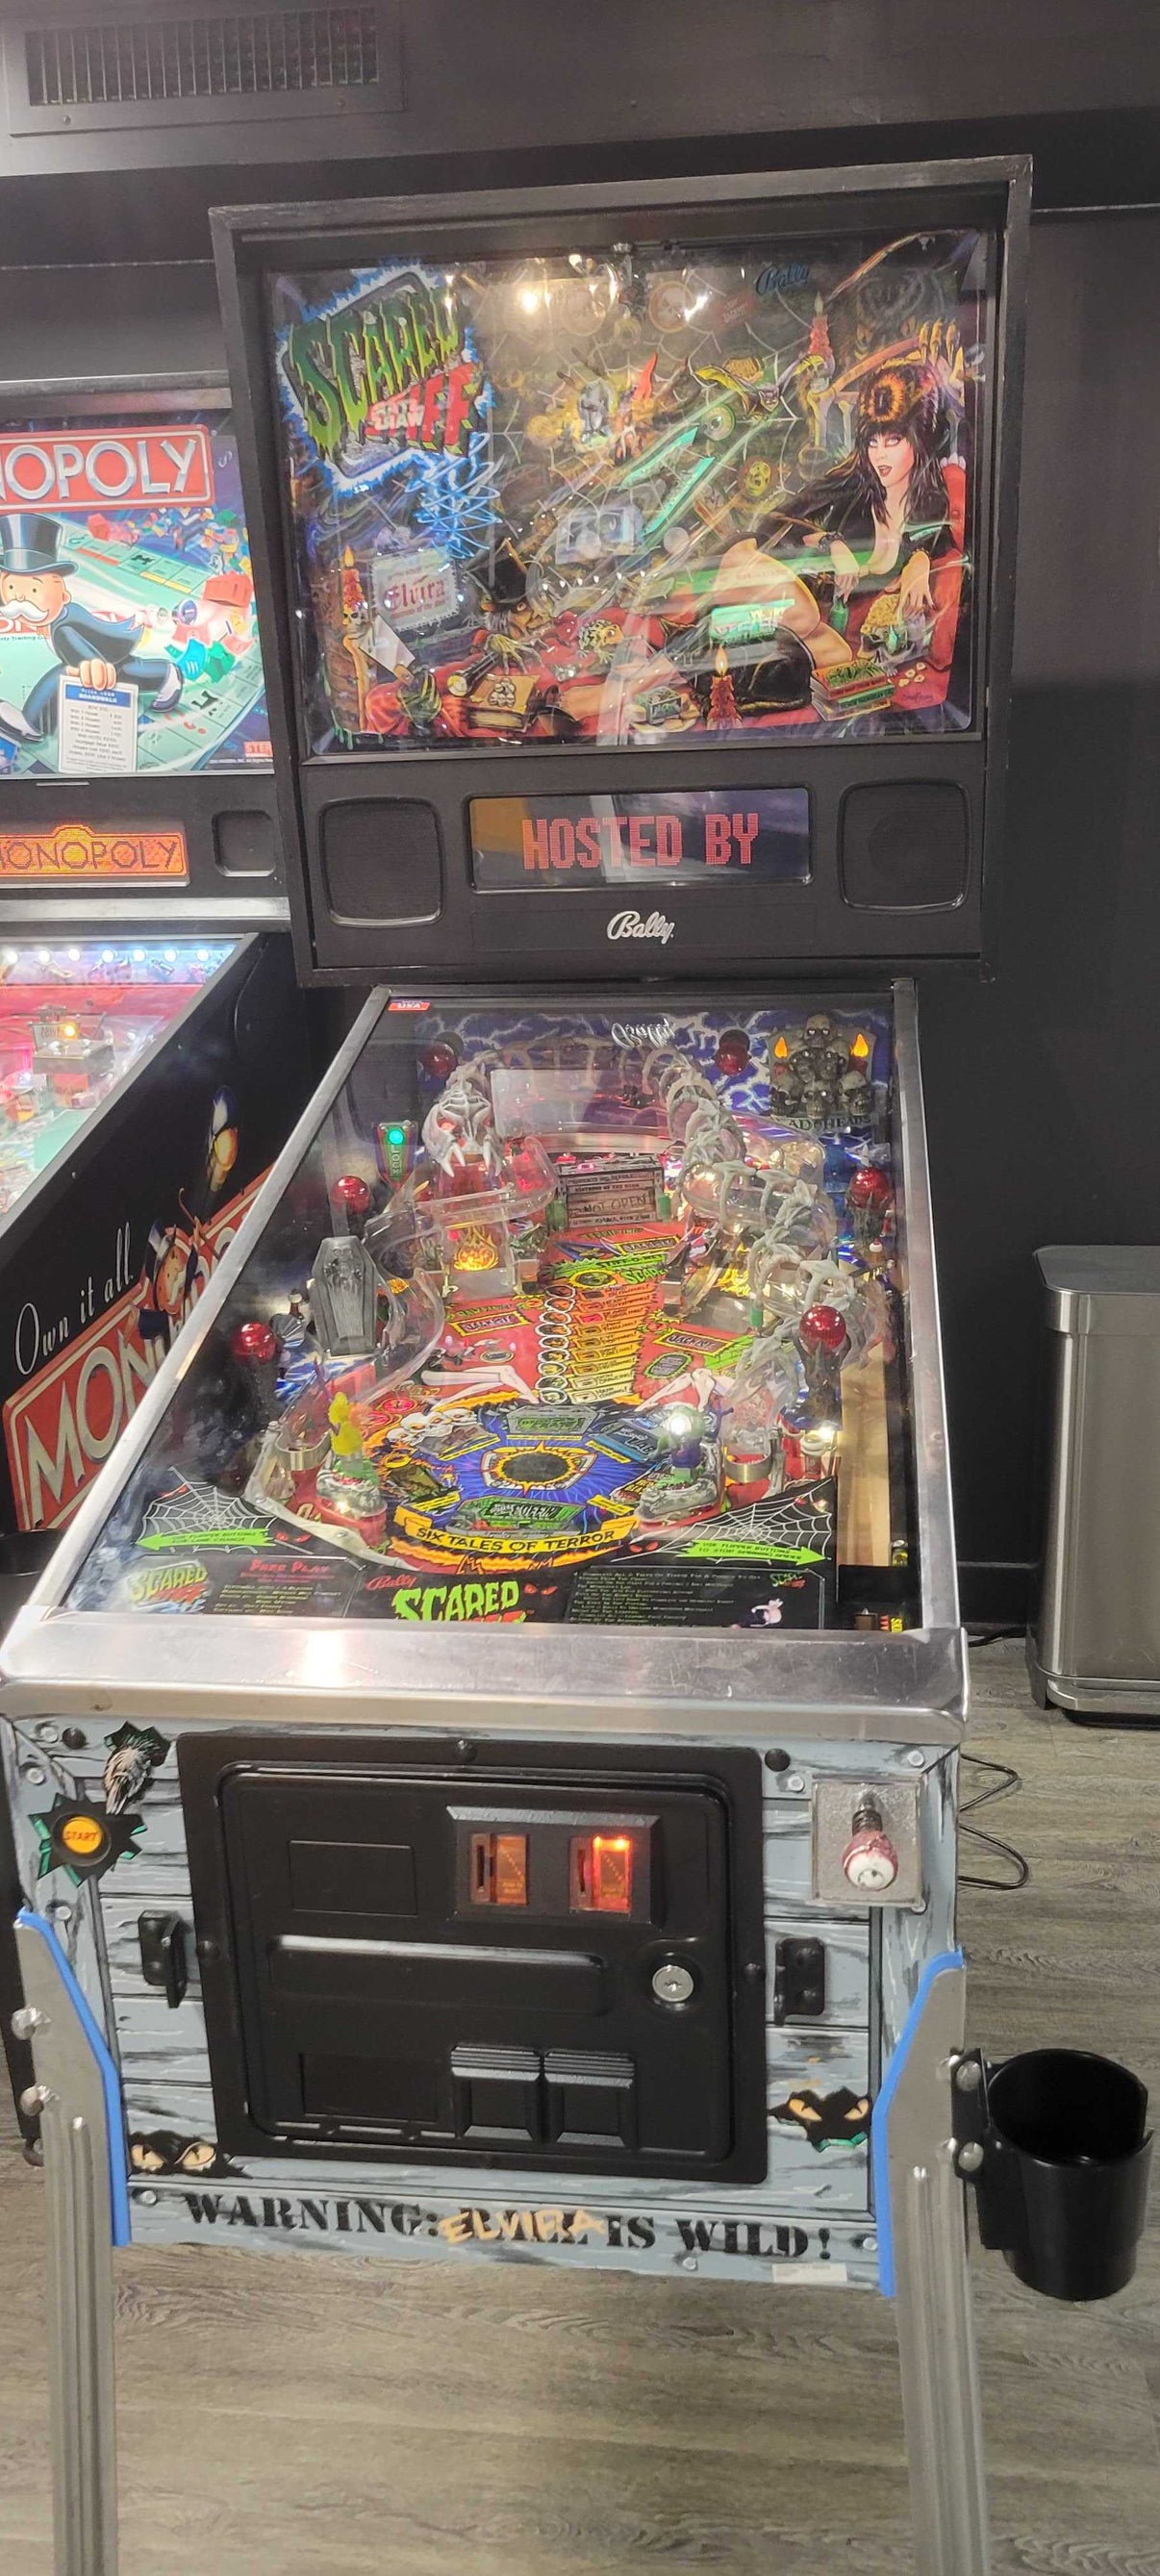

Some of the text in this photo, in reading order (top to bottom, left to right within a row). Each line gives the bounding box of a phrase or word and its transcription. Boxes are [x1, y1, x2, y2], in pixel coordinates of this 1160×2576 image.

[756, 261, 810, 295] Bally
[288, 289, 460, 459] SCARED
[364, 362, 477, 455] IFF
[0, 439, 196, 501] OPOLY
[0, 840, 179, 871] ONOPOLY
[521, 812, 759, 870] HOSTED BY
[606, 911, 675, 945] Bally
[15, 1302, 70, 1376] Own
[80, 1276, 94, 1325] it
[416, 1527, 615, 1552] SIX TALES OF TERROR
[366, 1574, 417, 1590] Bally
[391, 1580, 520, 1622] SCARED
[65, 1831, 98, 1841] START
[183, 2192, 440, 2236] WARNING:
[438, 2208, 606, 2245] ELVIRA
[606, 2214, 657, 2249] IS
